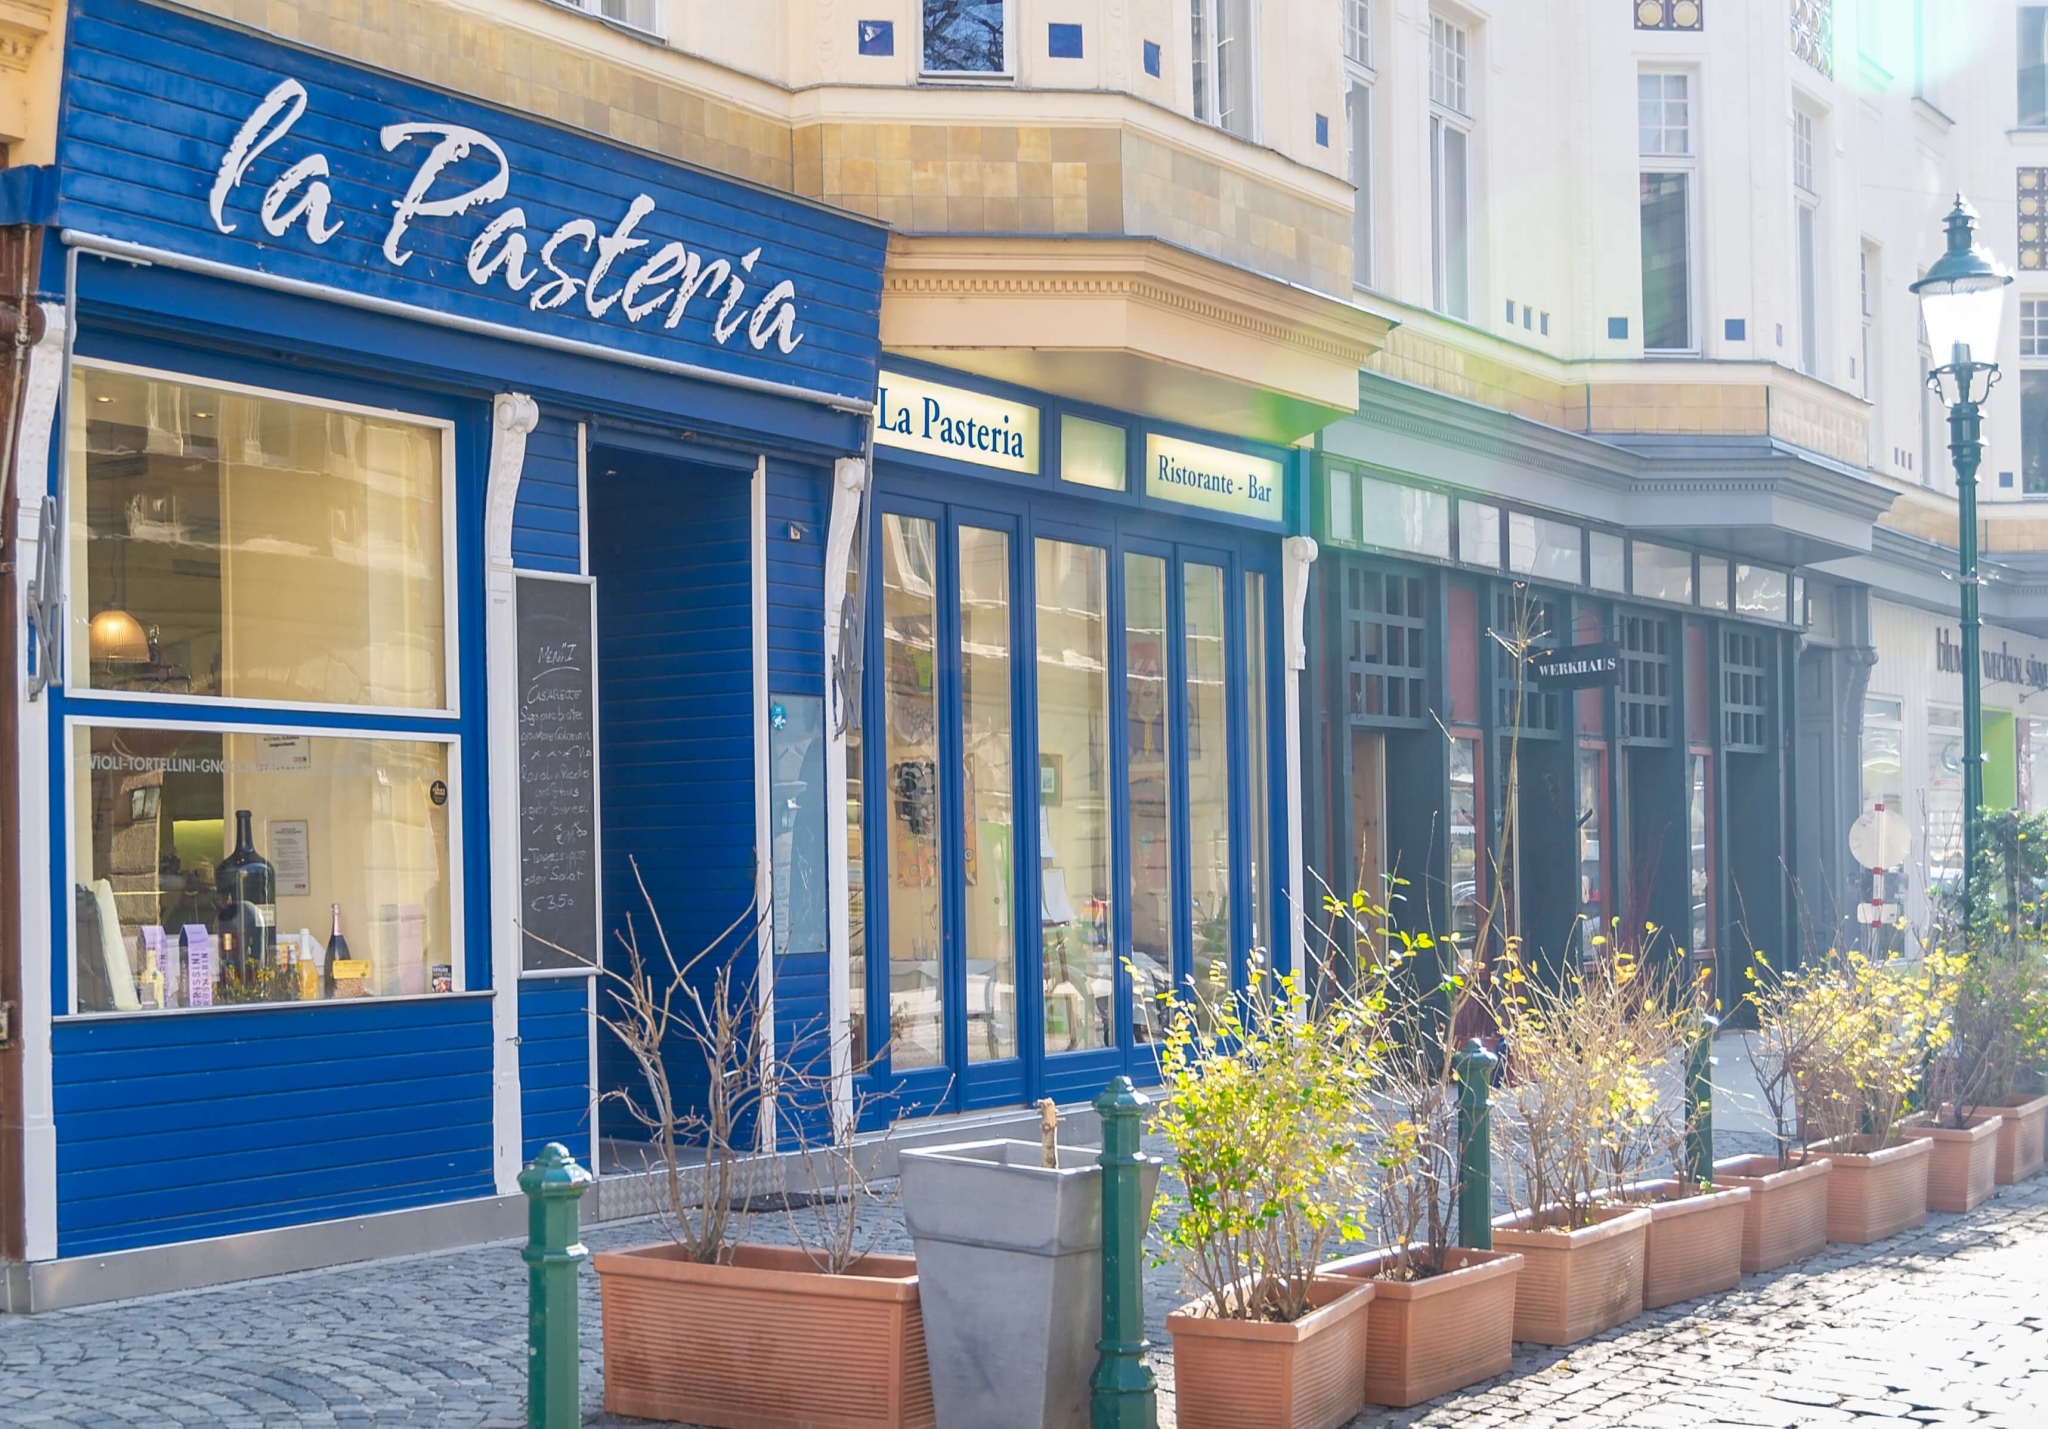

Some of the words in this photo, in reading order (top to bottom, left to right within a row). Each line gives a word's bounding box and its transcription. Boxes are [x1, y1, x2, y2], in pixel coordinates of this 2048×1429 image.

[209, 78, 343, 245] la
[380, 121, 804, 355] Pasteria
[877, 387, 913, 436] La
[922, 396, 1025, 459] Pasteria
[1157, 454, 1234, 496] Ristorante
[1247, 474, 1272, 503] Bar
[1538, 657, 1616, 677] WERKHAUS
[191, 953, 202, 1006] GRISSINI
